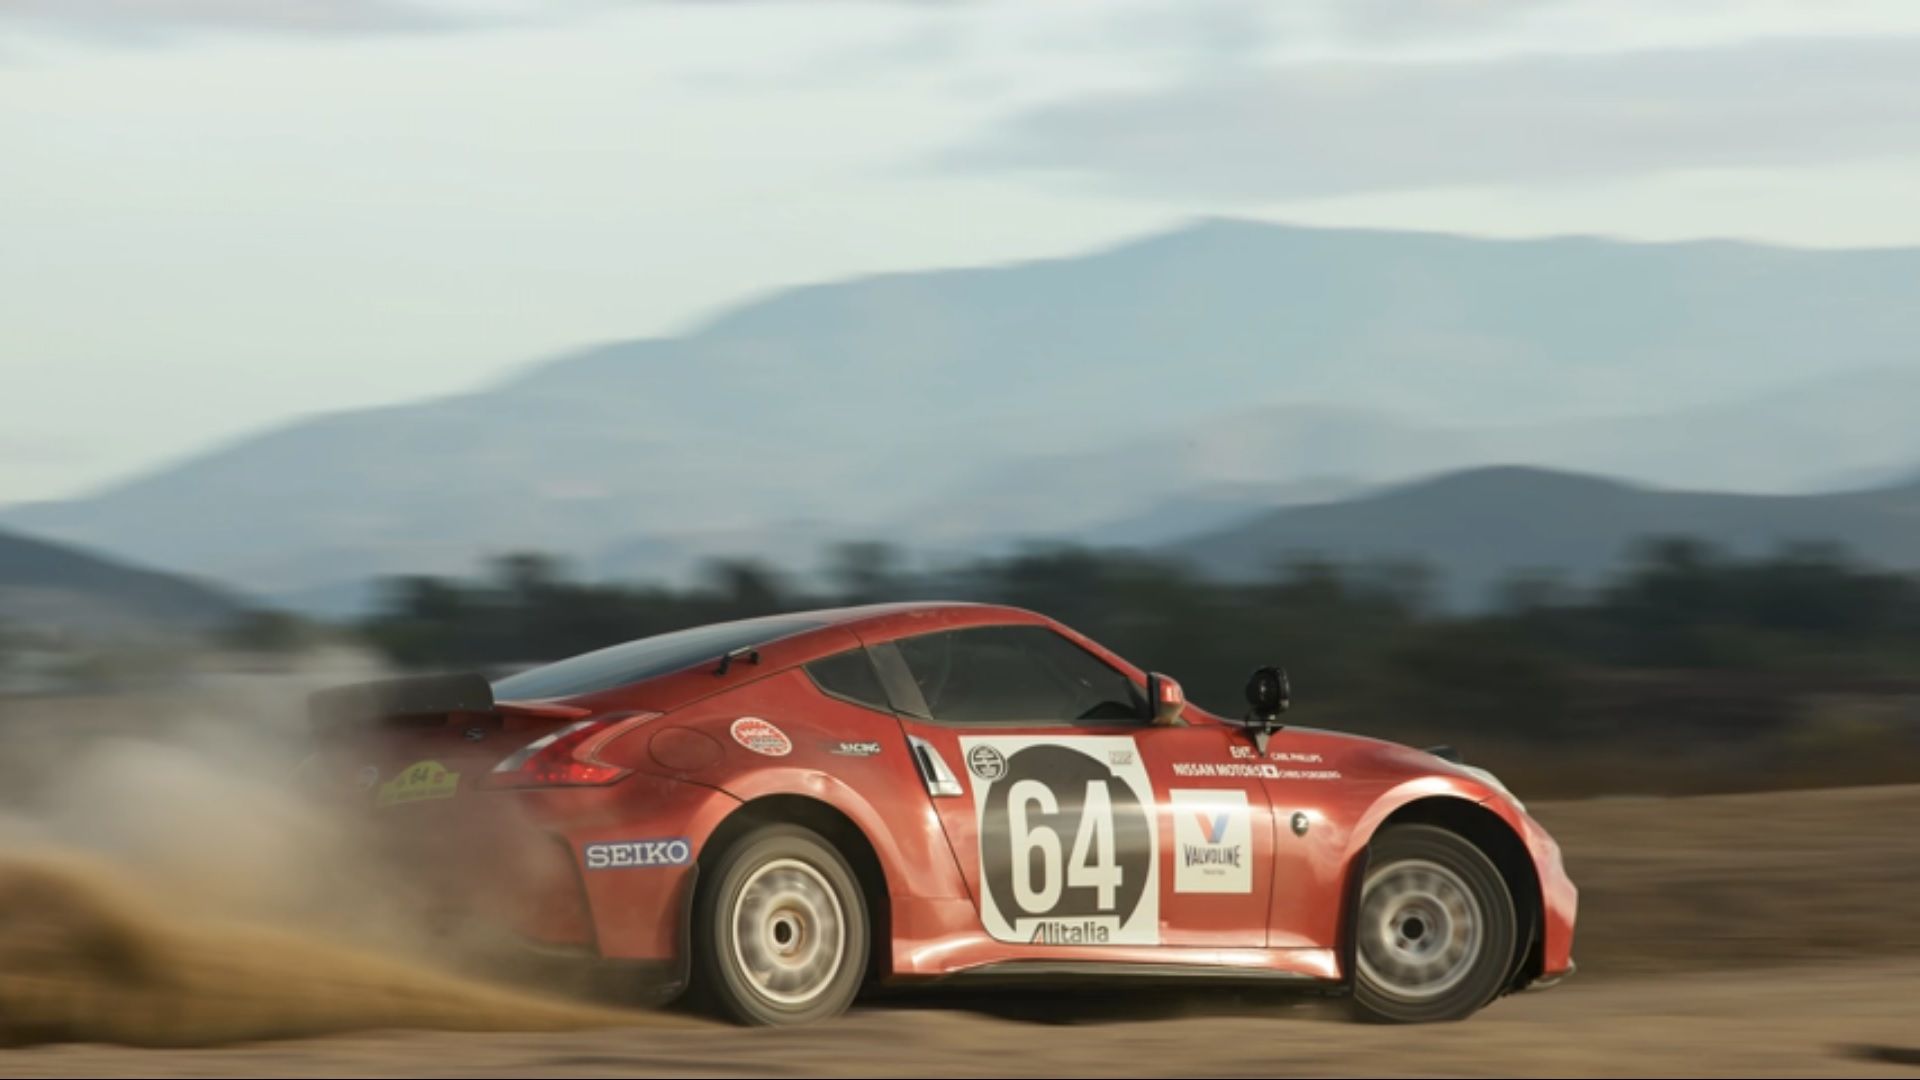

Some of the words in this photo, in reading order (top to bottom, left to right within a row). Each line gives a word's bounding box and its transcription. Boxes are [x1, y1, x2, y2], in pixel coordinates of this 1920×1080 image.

[1173, 763, 1216, 776] NISSAN
[1215, 764, 1262, 777] MOTORS
[586, 839, 690, 868] SEIKO
[1007, 779, 1123, 914] 64
[1183, 843, 1241, 869] VALVOLINE
[1029, 921, 1110, 945] Alitalia
